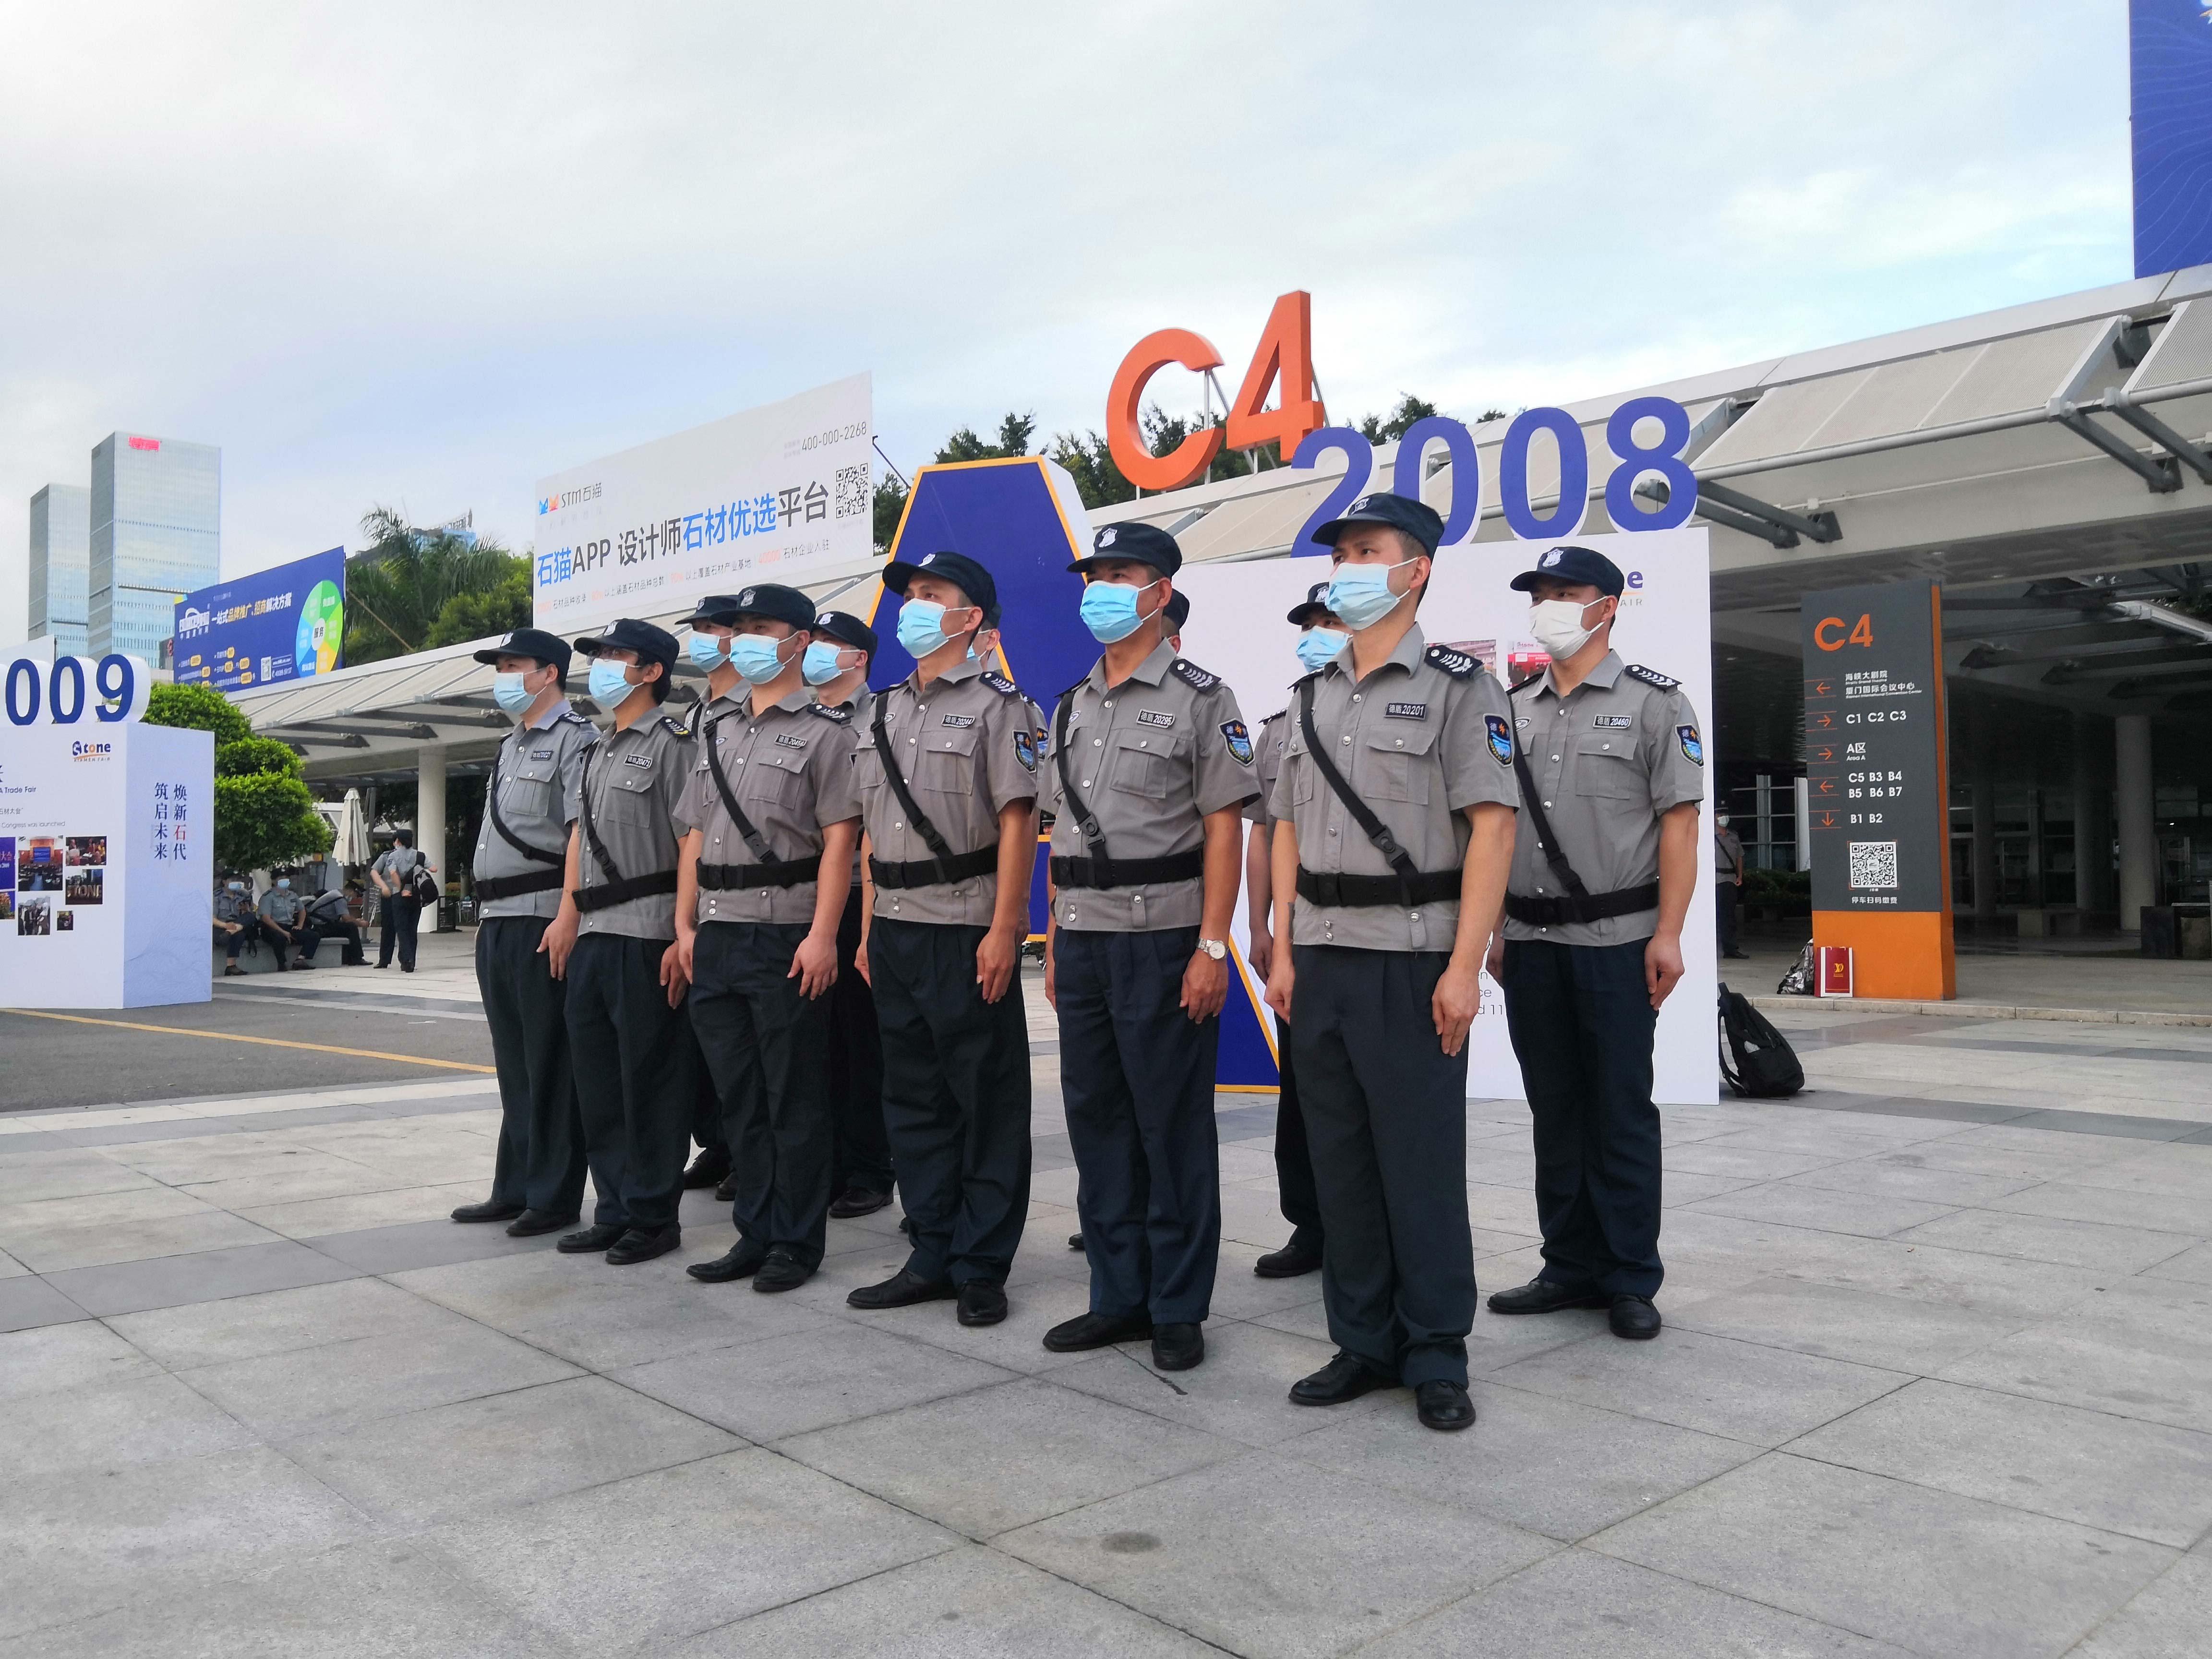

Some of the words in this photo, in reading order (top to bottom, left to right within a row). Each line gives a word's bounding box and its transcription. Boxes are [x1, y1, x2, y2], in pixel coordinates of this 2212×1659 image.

[1106, 289, 1324, 490] C4
[802, 421, 866, 451] 400-000-2268
[1291, 396, 1698, 557] 2008
[618, 481, 829, 567] 设计师石材优选平台
[1814, 614, 1874, 651] C4
[5, 654, 135, 725] 009
[1845, 682, 1915, 695] 厦门国际会议中心
[1846, 713, 1861, 724] C1
[1867, 711, 1885, 722] C2
[1889, 710, 1907, 721] C3
[1846, 742, 1866, 754] A区
[1848, 772, 1865, 783] C5
[1869, 771, 1883, 782] B3
[1888, 770, 1902, 781] B4
[1849, 788, 1862, 798] B5
[1870, 787, 1883, 797] B6
[1888, 786, 1902, 796] B7
[154, 782, 168, 860] 筑启未来
[173, 783, 187, 861] 焕新石代
[1851, 814, 1863, 824] B1
[1869, 813, 1883, 823] B2
